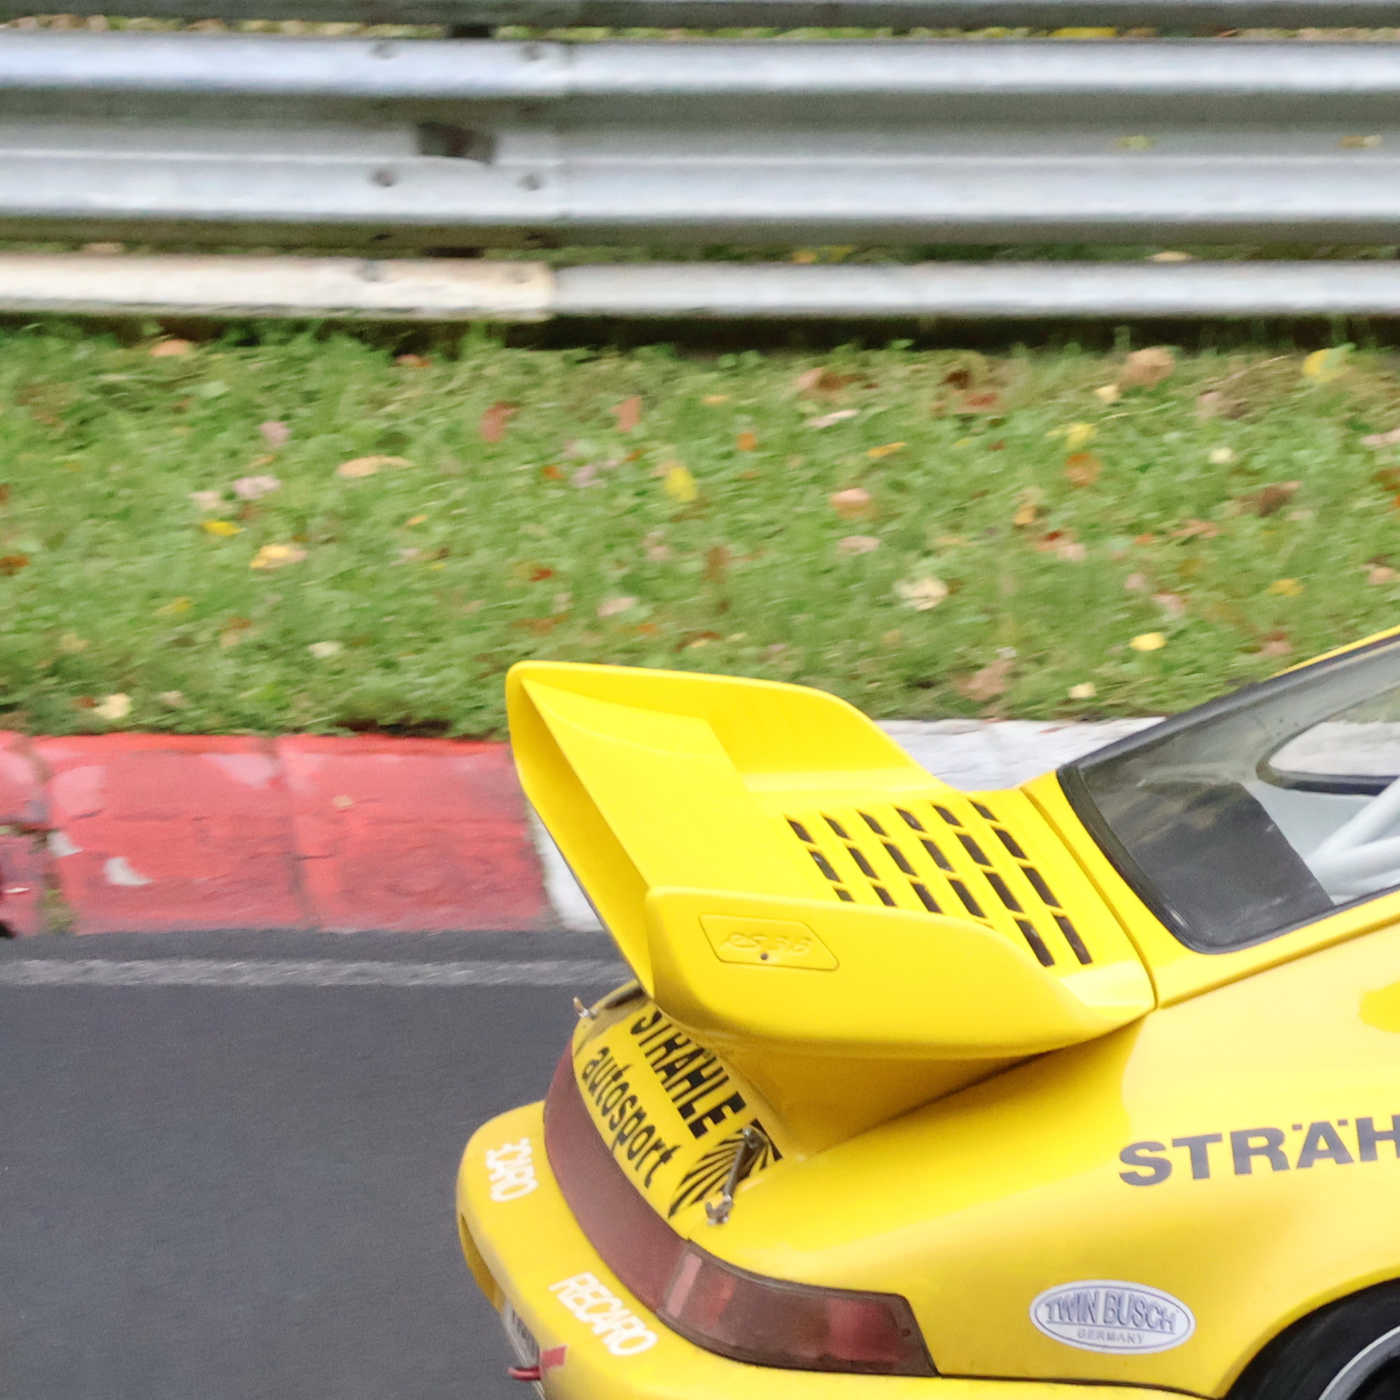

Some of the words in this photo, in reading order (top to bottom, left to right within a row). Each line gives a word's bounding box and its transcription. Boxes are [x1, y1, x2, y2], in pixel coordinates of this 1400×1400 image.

[581, 1046, 681, 1189] autosport
[547, 1271, 659, 1356] RECARO
[1045, 1290, 1099, 1324] TWIN
[1102, 1290, 1176, 1332] BUSCH
[1077, 1329, 1145, 1345] GERMANY
